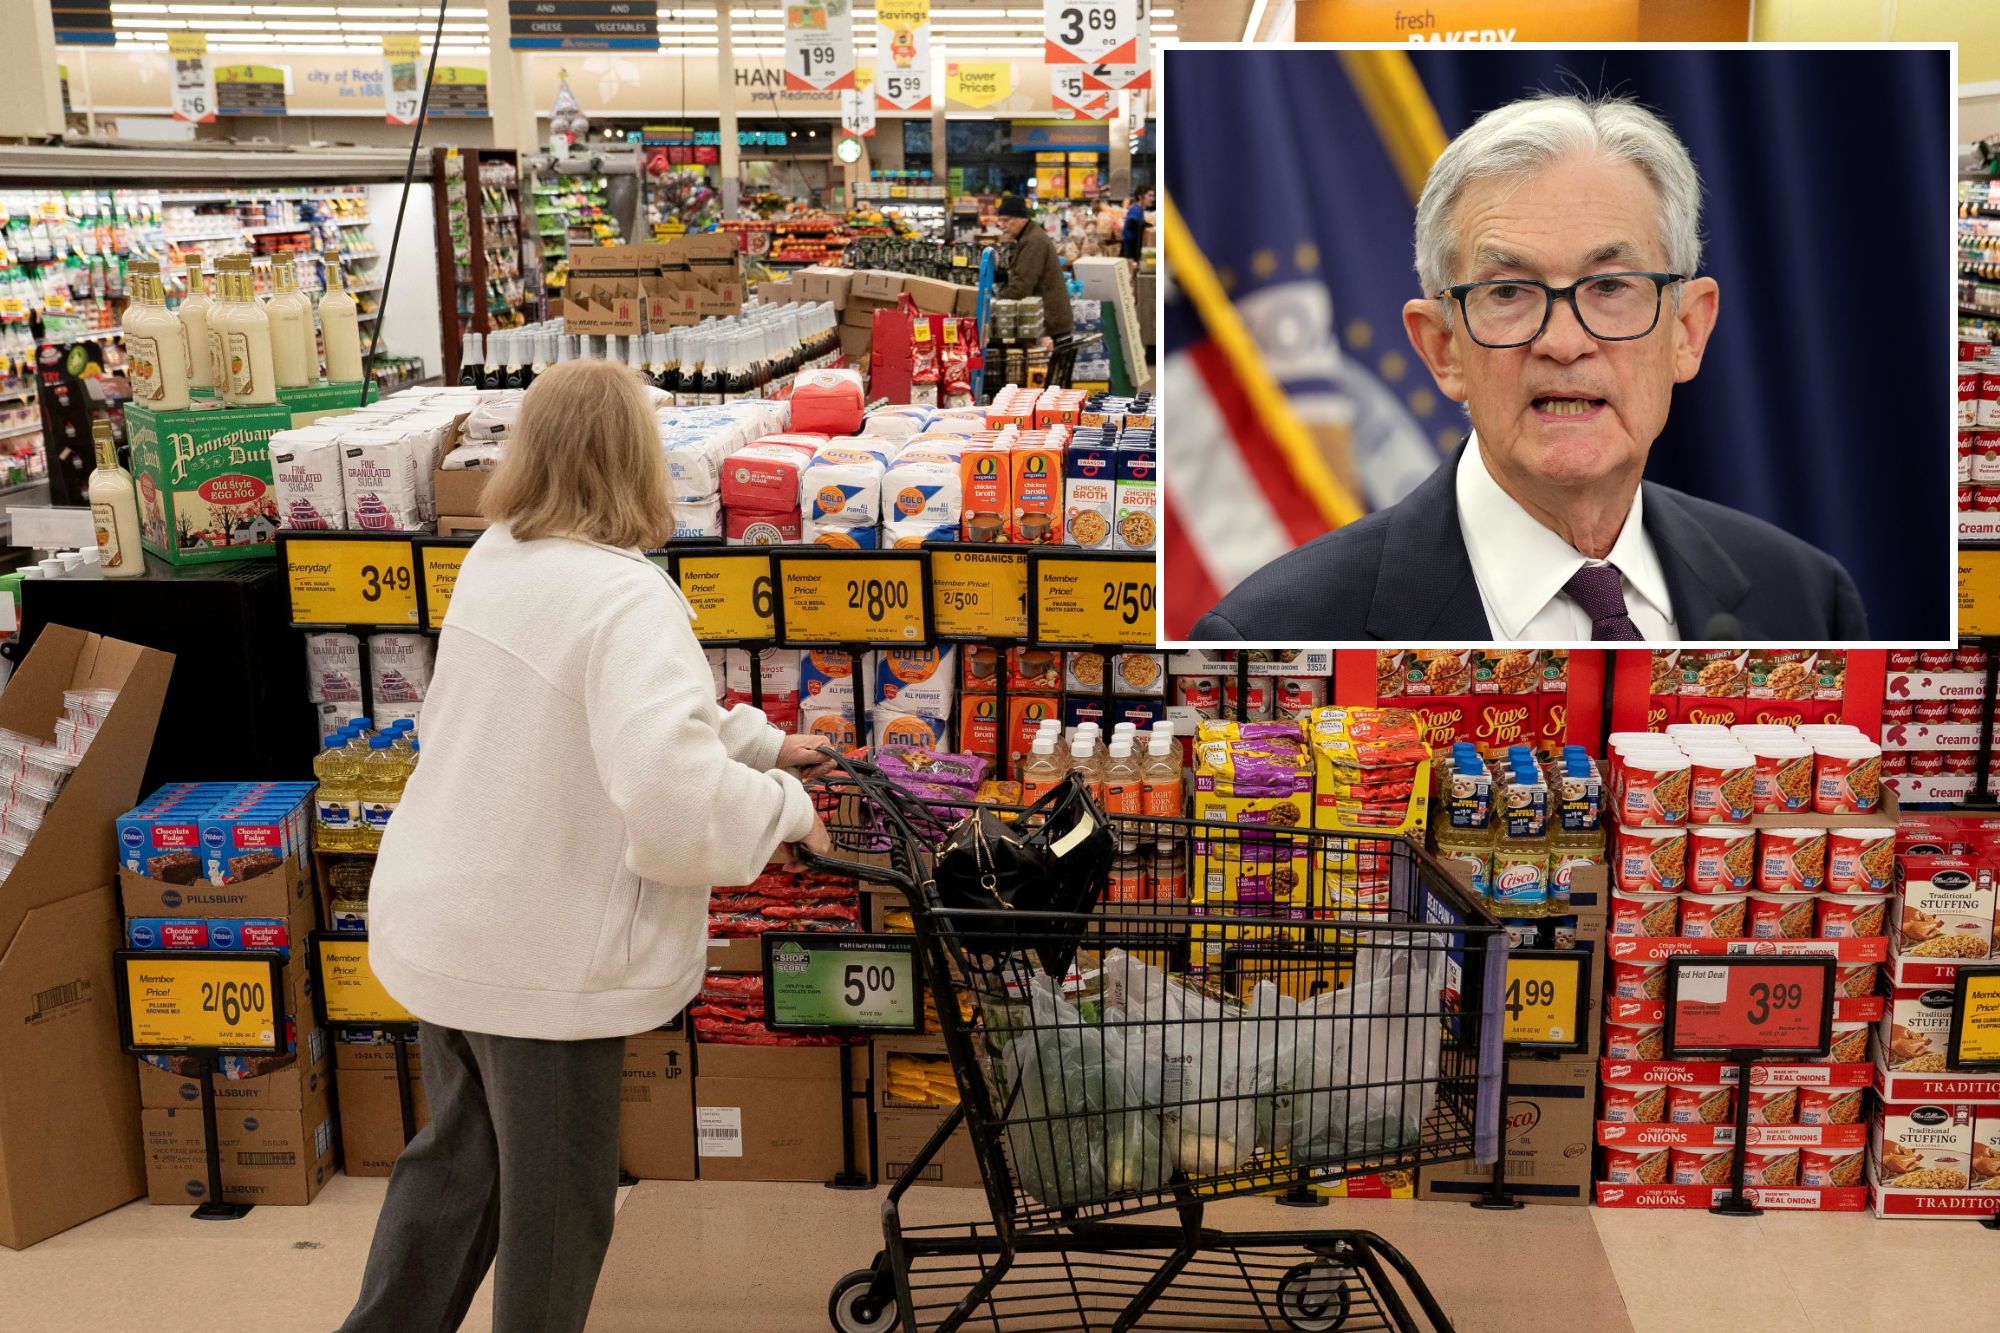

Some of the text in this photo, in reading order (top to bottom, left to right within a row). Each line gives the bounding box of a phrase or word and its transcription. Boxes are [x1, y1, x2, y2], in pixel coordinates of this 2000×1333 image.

[536, 4, 555, 13] AND
[610, 4, 629, 13] AND
[878, 10, 927, 21] Savings
[1395, 9, 1435, 30] fresh
[531, 23, 562, 32] CHEESE
[595, 23, 646, 32] VEGETABLES
[308, 70, 330, 84] city
[449, 68, 457, 81] 3
[735, 68, 786, 87] HAN
[959, 72, 996, 81] Lower
[960, 83, 997, 93] Prices
[752, 89, 834, 102] your Redmond
[166, 428, 285, 486] Pennsylvan
[228, 445, 270, 466] Dut
[361, 459, 376, 469] FINE
[291, 465, 306, 474] FINE
[348, 468, 391, 478] GRANULATED
[279, 473, 322, 483] GRANULATED
[357, 477, 383, 488] SUGAR
[212, 480, 252, 491] Old Style
[288, 482, 315, 493] SUGAR
[211, 489, 256, 500] EGG NOG
[820, 493, 843, 503] GOLD
[1072, 491, 1108, 500] BROTH
[900, 495, 923, 504] GOLD
[1122, 497, 1156, 505] BROTH
[1958, 522, 1993, 534] Cream
[964, 553, 1014, 564] ORGANICS
[288, 563, 332, 574] Everyday!
[685, 571, 720, 580] Member
[787, 574, 822, 582] Member
[1043, 574, 1078, 583] Member
[691, 584, 716, 593] Price!
[967, 580, 990, 588] Price!
[794, 586, 817, 595] Price!
[1049, 587, 1073, 596] Price!
[324, 638, 339, 647] FINE
[385, 638, 399, 646] FINE
[1705, 650, 1732, 661] TURKEY
[1773, 653, 1800, 664] TURKEY
[1306, 663, 1327, 672] 33534
[1939, 685, 1975, 696] Cream
[917, 692, 941, 700] PURPOSE
[1689, 709, 1736, 725] Stove
[1756, 711, 1803, 725] Stove
[1475, 706, 1529, 738] Stove
[974, 731, 994, 739] broth
[1496, 723, 1522, 745] Top
[1936, 735, 1970, 745] Cream
[1151, 790, 1172, 799] LIGHT
[1929, 787, 1964, 798] Cream
[155, 827, 189, 836] Chocolate
[236, 827, 271, 836] Chocolate
[123, 834, 144, 842] Pillsbury
[162, 834, 184, 842] Fudge
[204, 834, 225, 842] Pillsbury
[243, 834, 265, 842] Fudge
[1765, 858, 1786, 866] CRISPY
[1499, 871, 1535, 890] Crisco
[187, 895, 245, 904] PILLSBURY
[1920, 900, 1979, 910] STUFFING
[165, 927, 199, 935] Chocolate
[133, 932, 153, 941] Pillsbury
[172, 934, 193, 942] Fudge
[213, 933, 233, 941] Pillsbury
[251, 934, 273, 942] Fudge
[1658, 942, 1679, 950] Crispy
[326, 954, 361, 962] Member
[779, 954, 805, 962] SHOP
[1649, 949, 1701, 958] ONIONS
[333, 966, 357, 975] Price!
[778, 963, 807, 972] SCORE
[139, 974, 175, 984] Member
[1692, 970, 1726, 979] Hot Deal
[145, 987, 170, 997] Price!
[622, 1070, 656, 1078] BOTTLES
[666, 1068, 682, 1079] UP
[1653, 1066, 1672, 1074] Crispy
[1643, 1072, 1694, 1083] ONIONS
[1773, 1074, 1827, 1083] REAL ONIONS
[1646, 1127, 1666, 1135] Crispy
[1637, 1133, 1688, 1143] ONIONS
[1788, 1134, 1818, 1142] ONIONS
[1899, 1134, 1957, 1144] STUFFING
[1645, 1189, 1664, 1197] Crispy
[1636, 1195, 1686, 1205] ONIONS
[1764, 1196, 1817, 1205] REAL ONIONS
